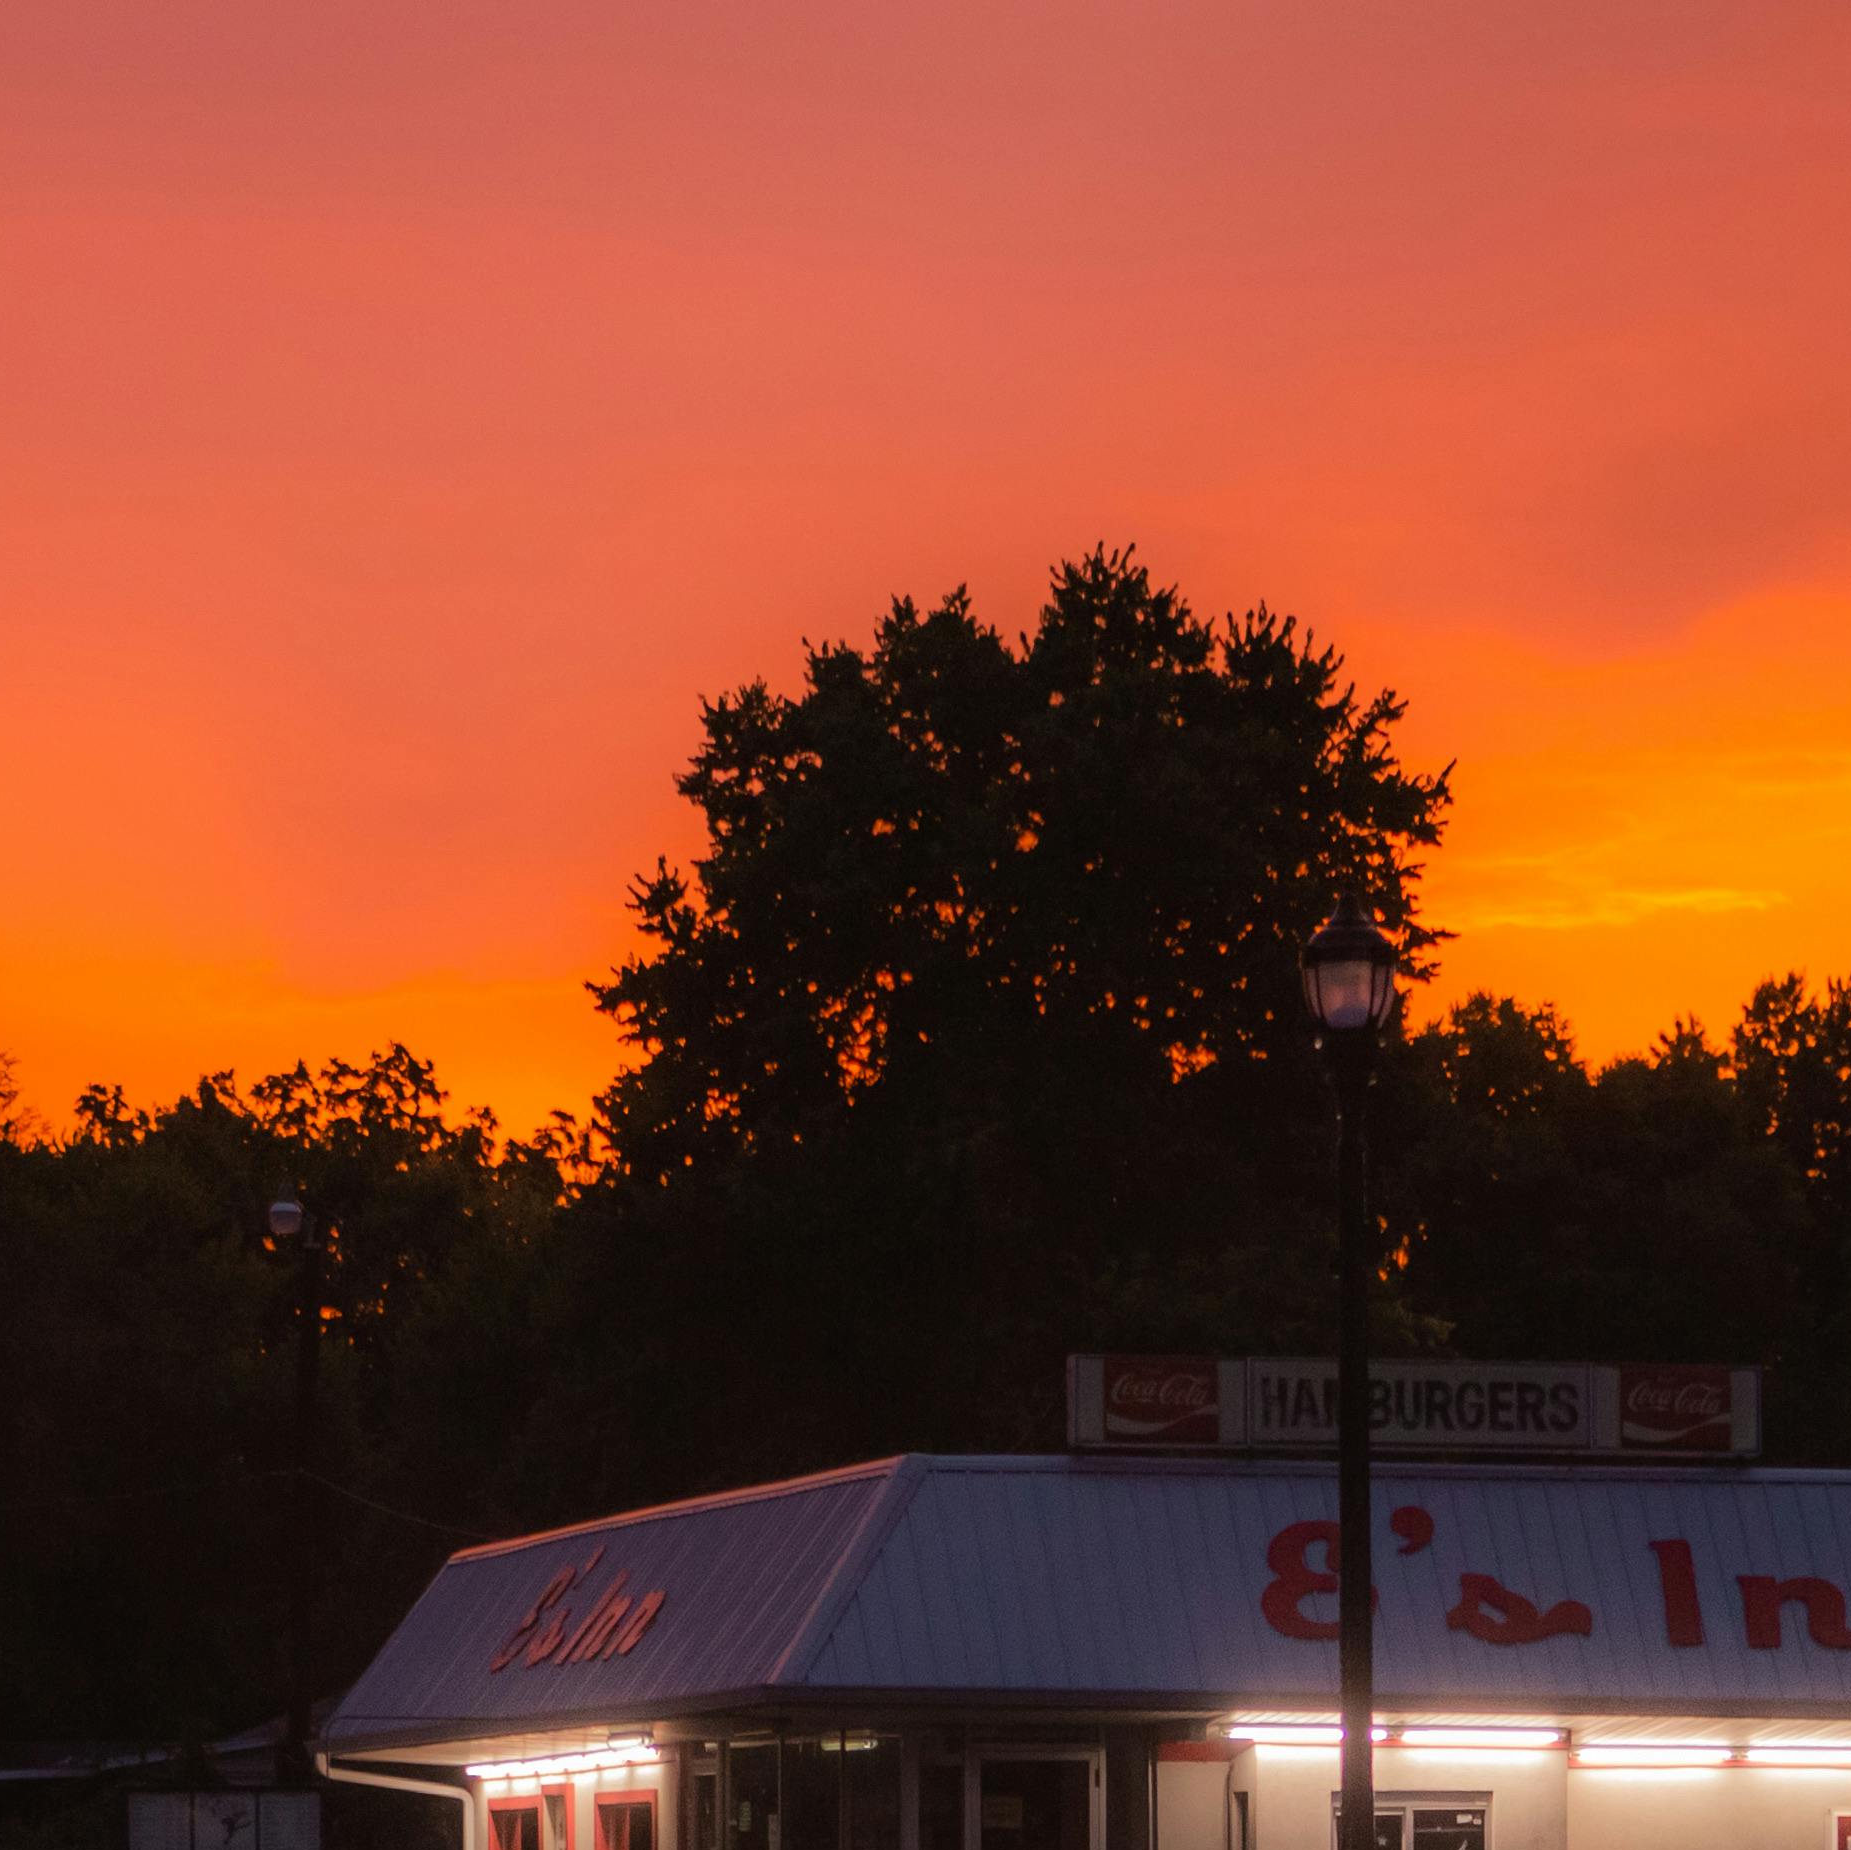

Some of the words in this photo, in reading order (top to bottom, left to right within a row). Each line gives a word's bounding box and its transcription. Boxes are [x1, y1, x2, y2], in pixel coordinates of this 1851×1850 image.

[490, 1543, 607, 1674] E's
[553, 1568, 667, 1665] Inn
[1261, 1506, 1593, 1645] E's
